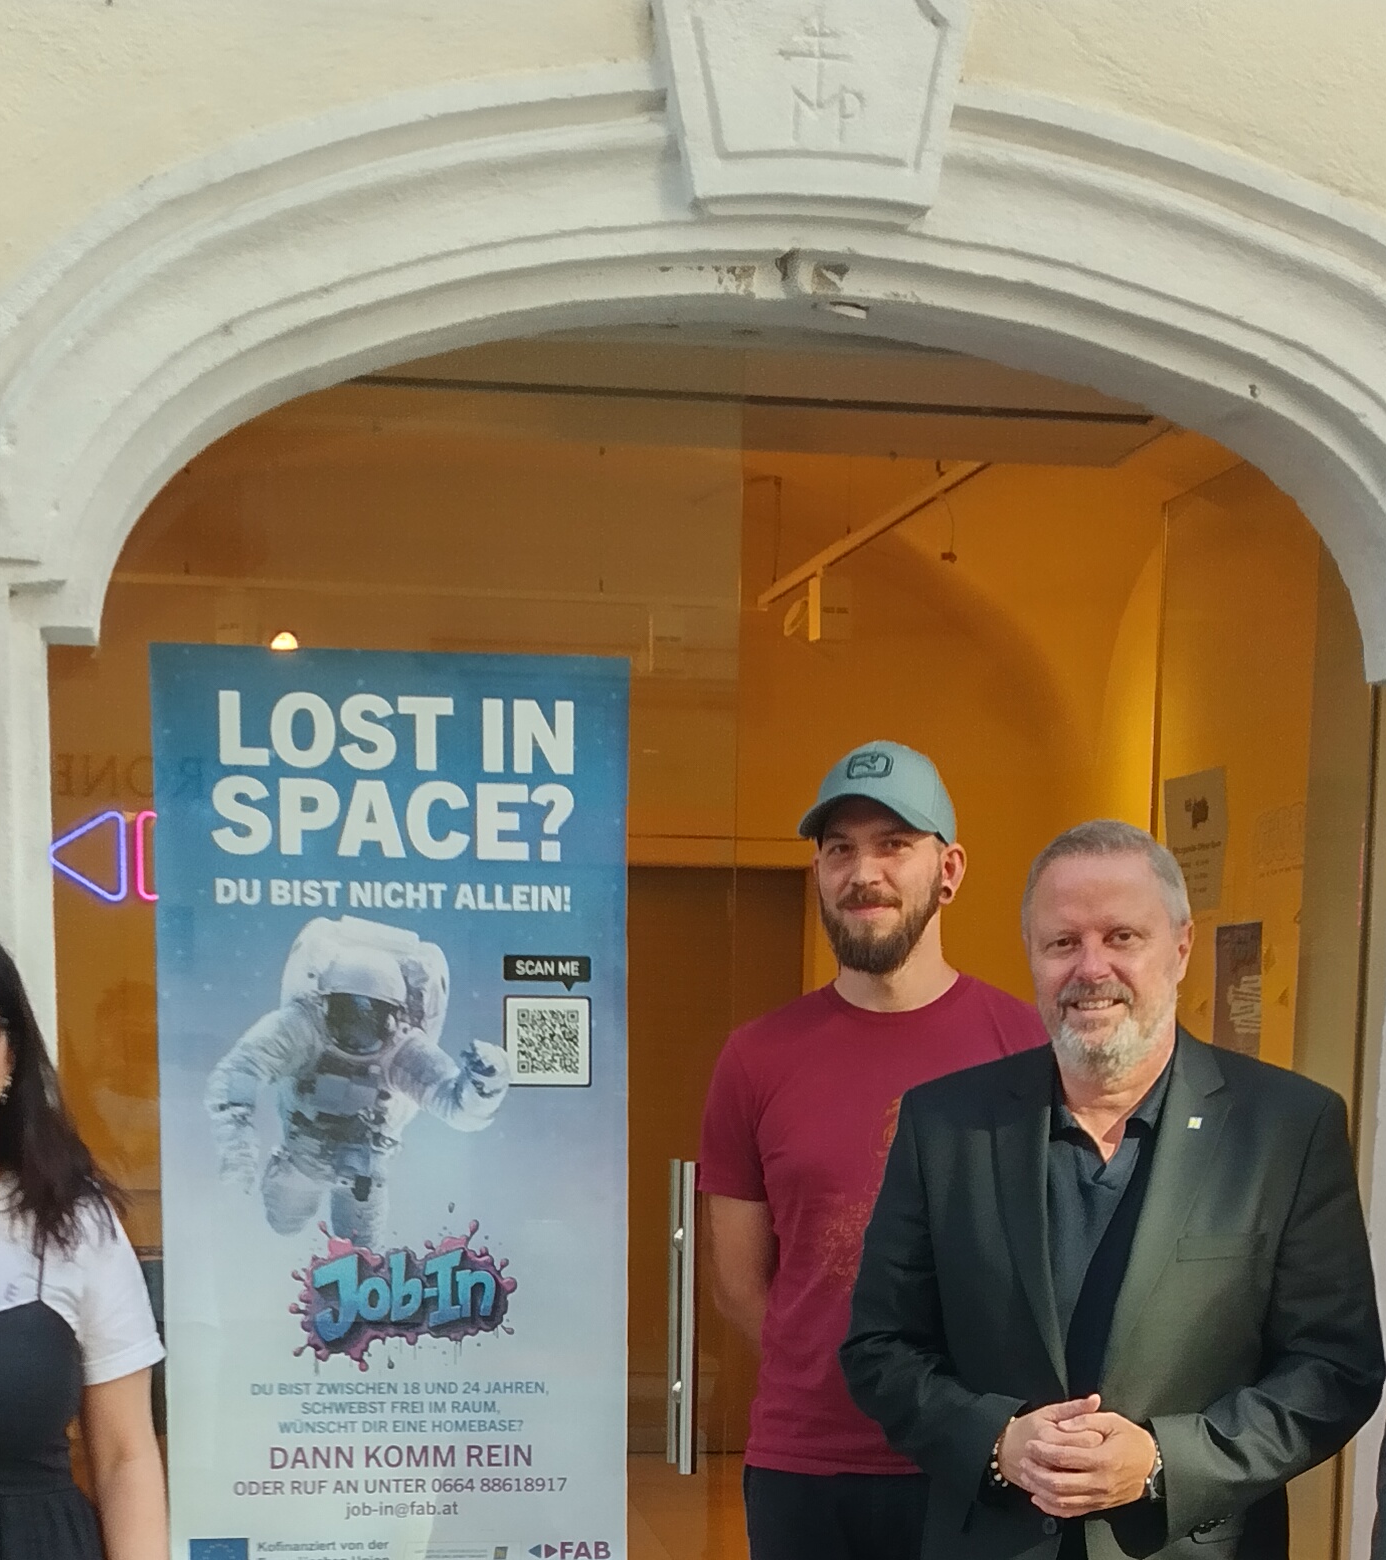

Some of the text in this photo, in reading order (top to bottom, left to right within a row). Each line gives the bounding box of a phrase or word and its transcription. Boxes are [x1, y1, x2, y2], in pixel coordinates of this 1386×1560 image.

[218, 690, 575, 775] LOST IN
[211, 774, 575, 862] SPACE?
[214, 876, 571, 912] DU BIST NICHT ALLEIN!
[515, 960, 580, 977] SCAN ME
[313, 1249, 497, 1342] Job-In
[250, 1381, 550, 1396] DU BIST ZWISCHEN 18 UND 24 JAHREN,
[301, 1401, 501, 1416] SCHWEBST FREI IM RAUM,
[278, 1418, 524, 1434] WÜNSCHT DIR EINE HOMEBASE?
[269, 1444, 534, 1470] DANN KOMM REIN
[232, 1477, 568, 1496] ODER RUF AN UNTER 0664 88618917
[344, 1501, 459, 1520] job-in@fab.at
[256, 1539, 389, 1553] Kofinanziert von der
[559, 1541, 611, 1560] FAB
